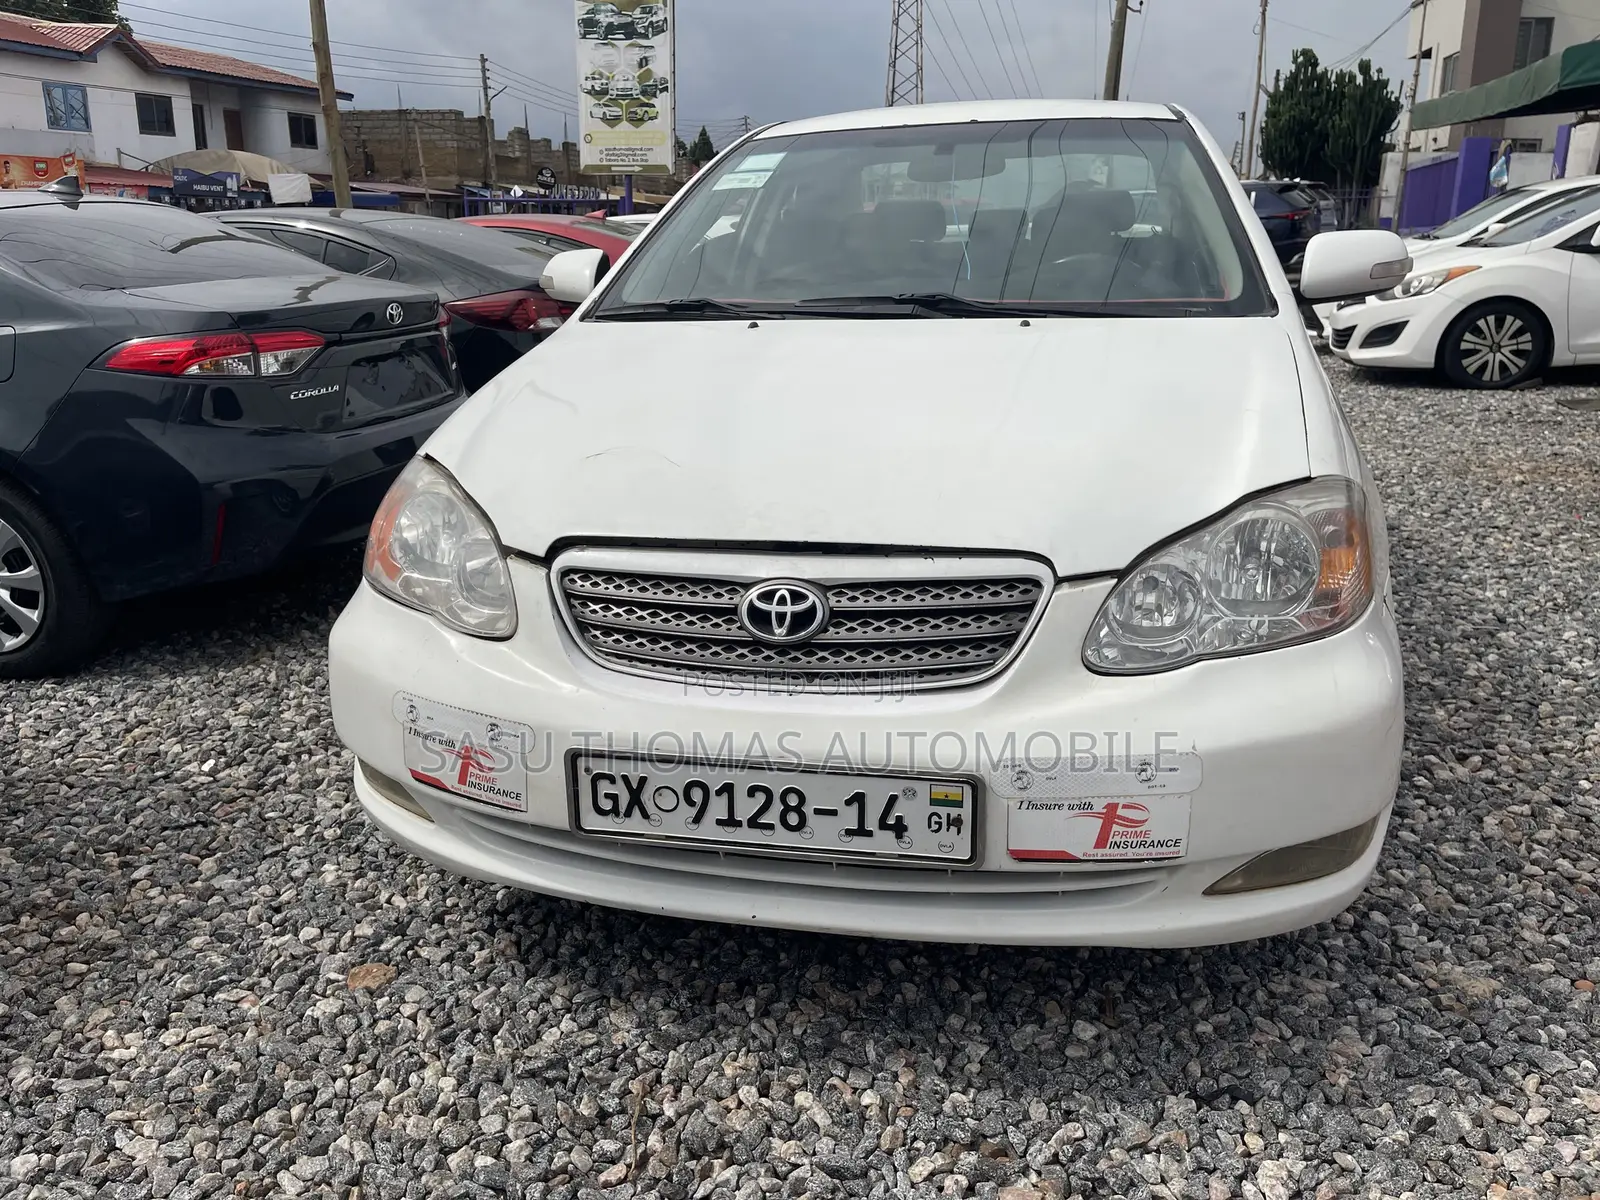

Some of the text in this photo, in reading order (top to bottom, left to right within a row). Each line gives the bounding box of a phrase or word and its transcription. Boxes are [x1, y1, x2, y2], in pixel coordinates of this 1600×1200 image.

[290, 384, 340, 400] COROLLA
[413, 727, 437, 743] Insure
[438, 738, 456, 750] with
[469, 771, 498, 786] PRIME
[467, 779, 523, 801] INSURANCE
[590, 772, 908, 840] GX 9128-14
[1017, 800, 1094, 811] I Insure with
[927, 811, 964, 836] GH
[1111, 829, 1152, 839] PRIME
[1108, 839, 1182, 850] INSURANCE
